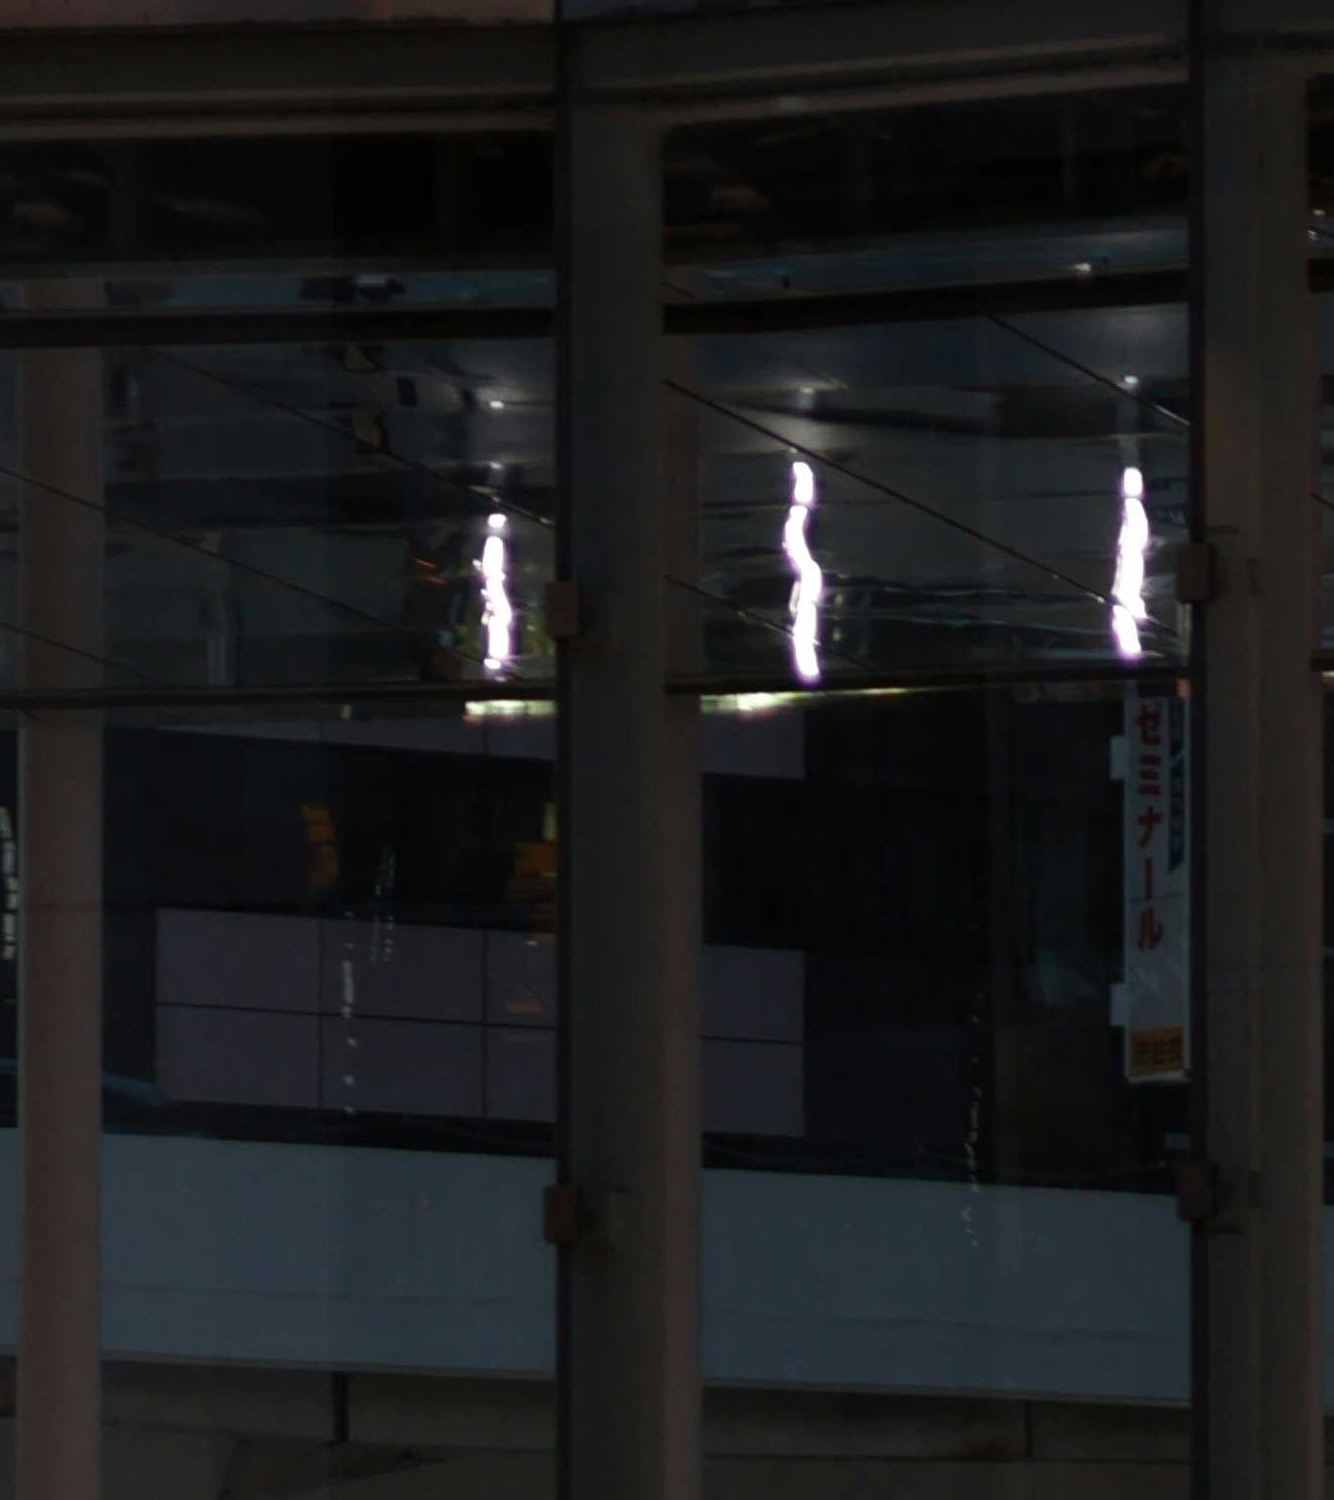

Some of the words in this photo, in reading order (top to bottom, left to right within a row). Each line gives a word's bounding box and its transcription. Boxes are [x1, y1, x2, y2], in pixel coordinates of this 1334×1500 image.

[1136, 700, 1163, 951] ゼミナール
